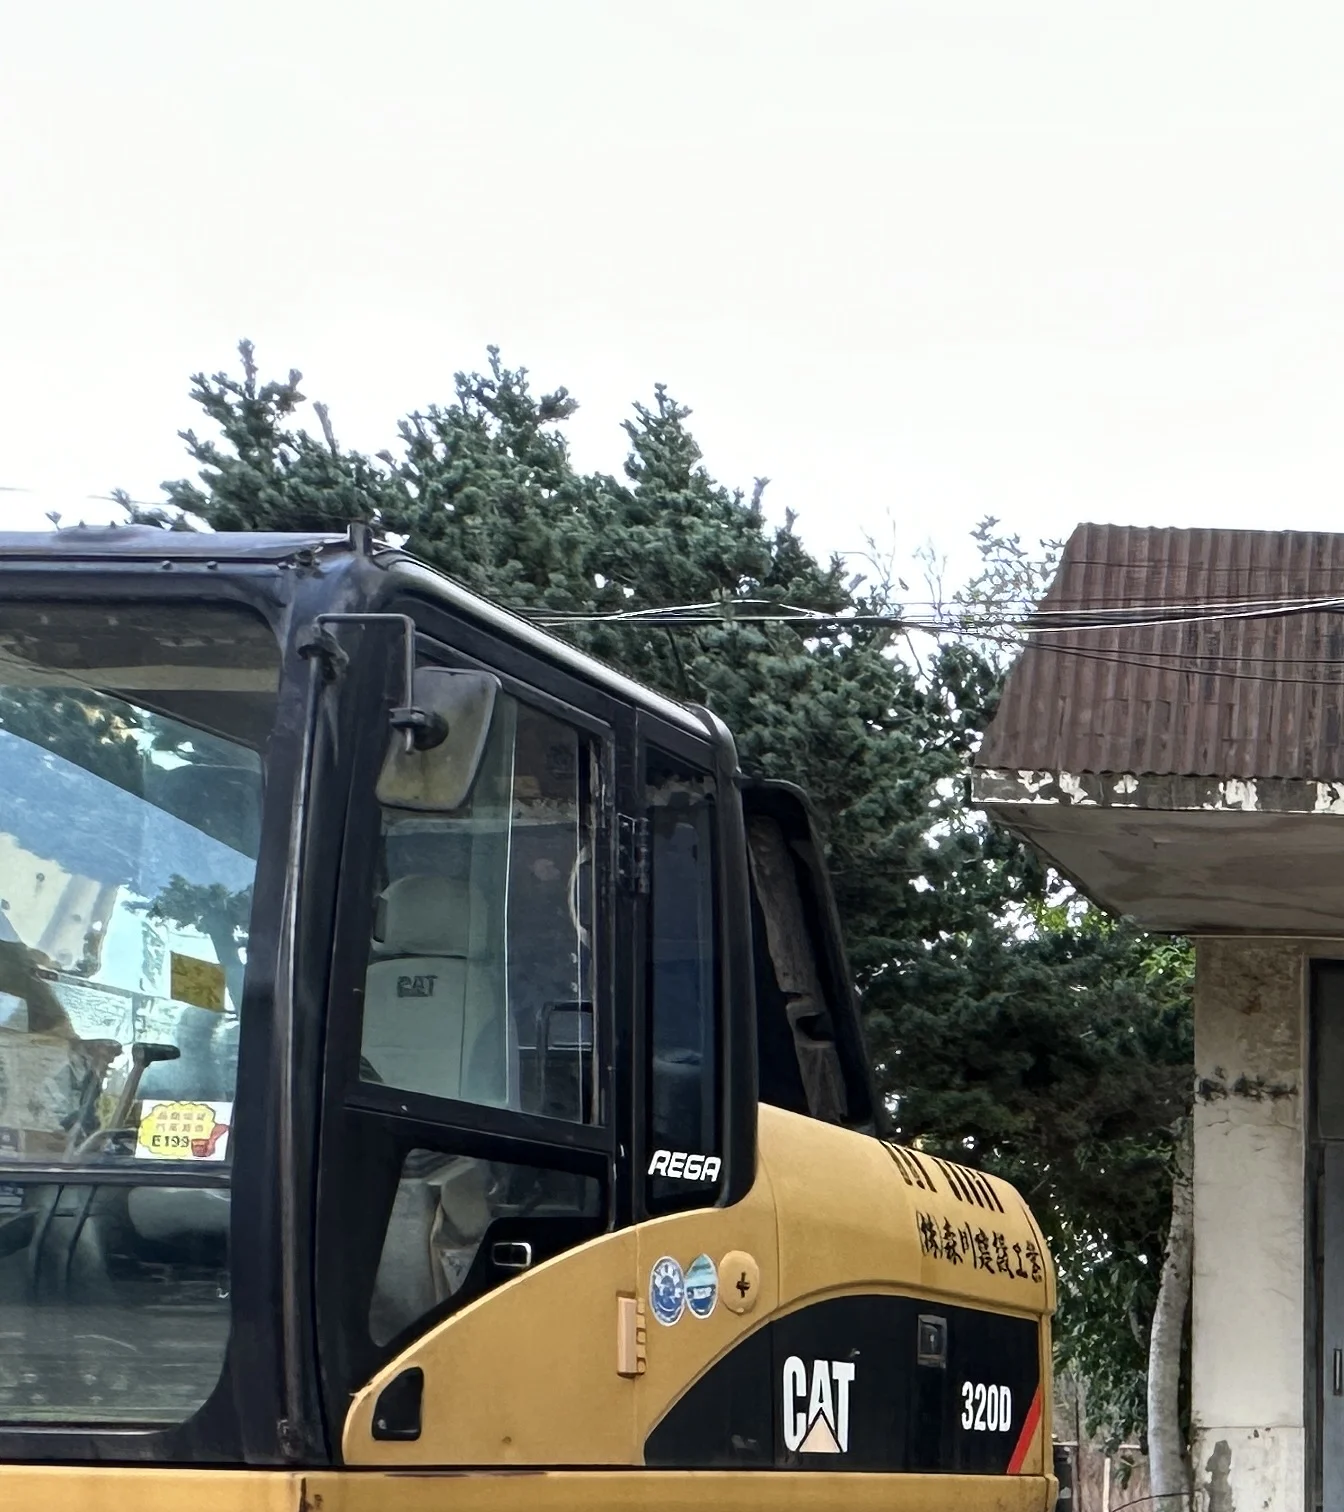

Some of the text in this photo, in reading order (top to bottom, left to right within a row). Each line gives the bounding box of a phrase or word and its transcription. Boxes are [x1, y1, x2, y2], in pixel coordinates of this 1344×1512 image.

[647, 1149, 722, 1182] REGA
[783, 1355, 856, 1453] CAT
[961, 1380, 1012, 1432] 320D
